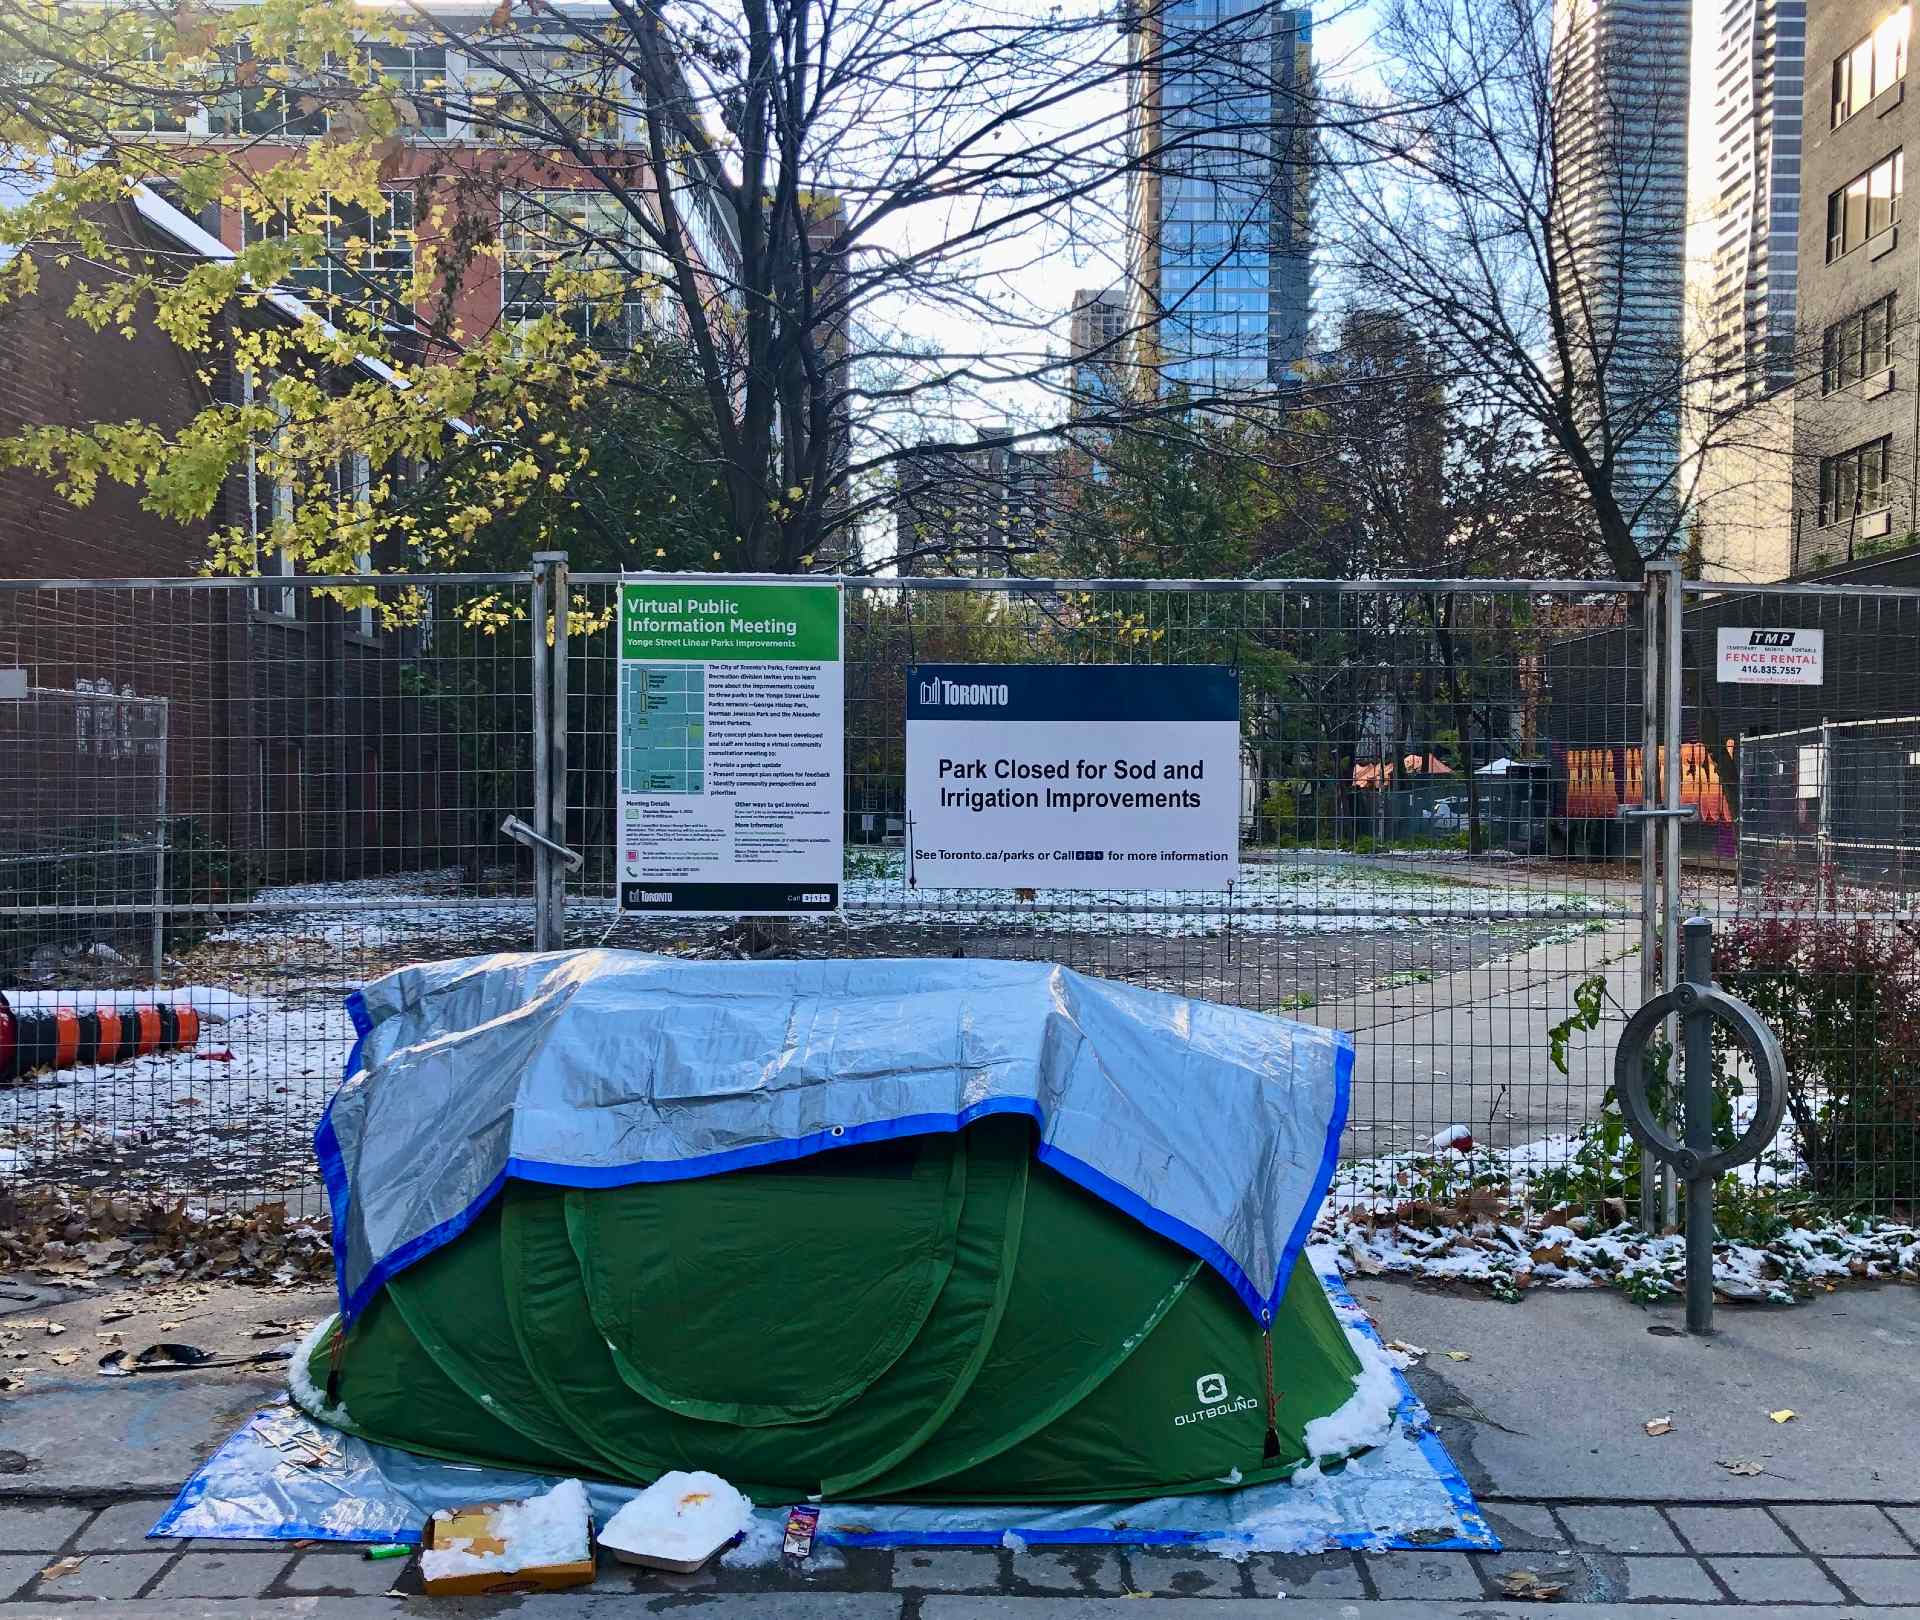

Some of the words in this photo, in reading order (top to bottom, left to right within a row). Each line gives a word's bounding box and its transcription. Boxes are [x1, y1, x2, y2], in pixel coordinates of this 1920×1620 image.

[628, 599, 682, 614] Virtual
[687, 599, 738, 614] Public
[628, 618, 725, 632] Information
[731, 619, 796, 635] Meeting
[627, 639, 653, 647] Yonge
[655, 639, 681, 647] Street
[683, 639, 708, 647] Linear
[711, 639, 734, 647] Parks
[736, 640, 795, 648] Improvements
[1755, 632, 1790, 644] TMP
[1726, 654, 1765, 662] FENCE
[1771, 655, 1816, 664] RENTAL
[1742, 666, 1801, 675] 416.835.7557
[942, 680, 1008, 705] TORONTO
[939, 759, 987, 780] Park
[994, 759, 1070, 780] Closed
[1076, 759, 1107, 780] for
[1114, 759, 1156, 780] Sod
[1163, 759, 1204, 780] and
[941, 788, 1039, 812] Irrigation
[1046, 788, 1201, 812] Improvements
[915, 850, 937, 860] See
[938, 850, 1035, 862] Toronto.ca/parks
[1038, 852, 1050, 861] or
[1053, 850, 1075, 861] Call
[1108, 850, 1124, 861] for
[1128, 852, 1157, 861] more
[1160, 850, 1228, 861] information
[641, 890, 672, 903] TORONTO
[1175, 1397, 1258, 1426] OUTBOUND
